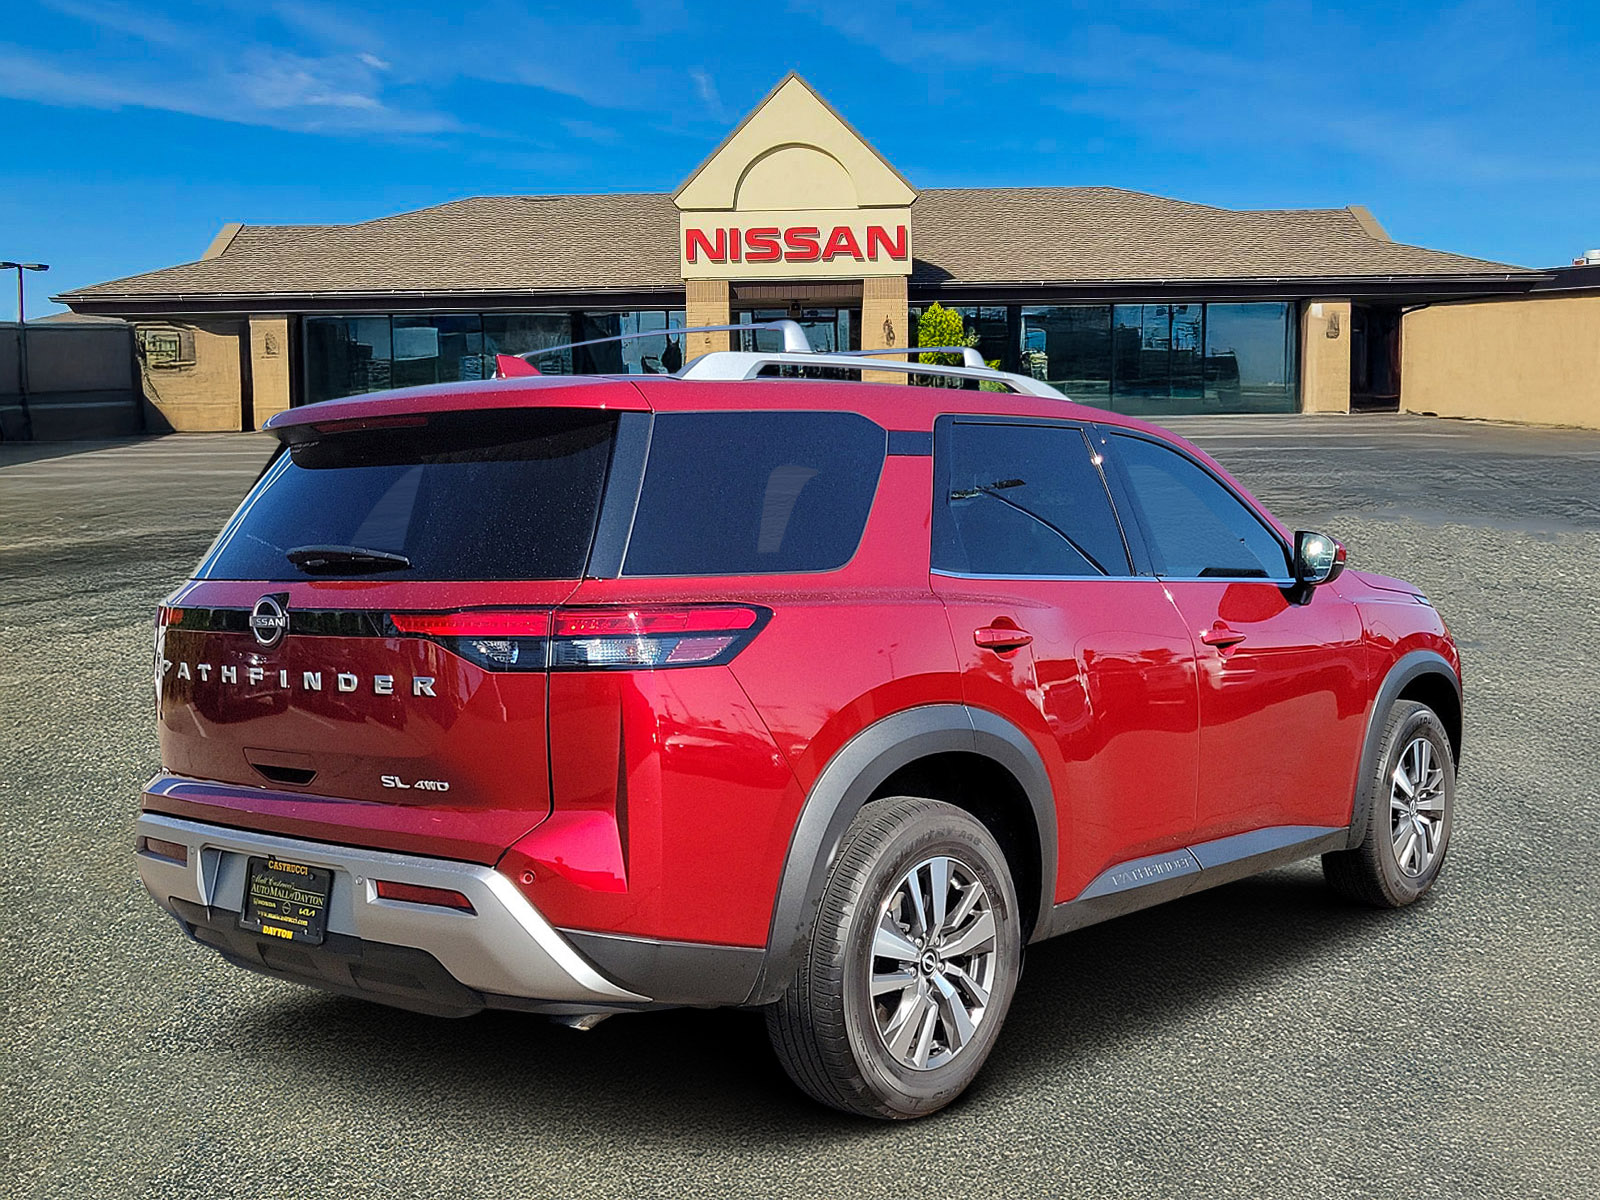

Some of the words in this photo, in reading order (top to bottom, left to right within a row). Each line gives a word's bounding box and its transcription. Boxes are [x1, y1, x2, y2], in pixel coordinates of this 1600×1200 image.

[685, 225, 907, 264] NISSAN
[161, 659, 437, 697] PATHFINDER
[380, 775, 410, 790] SL
[414, 780, 450, 792] 4WD
[268, 860, 308, 875] CASTRUCCI
[294, 892, 324, 905] DAYTON
[263, 926, 293, 939] DAYTON
